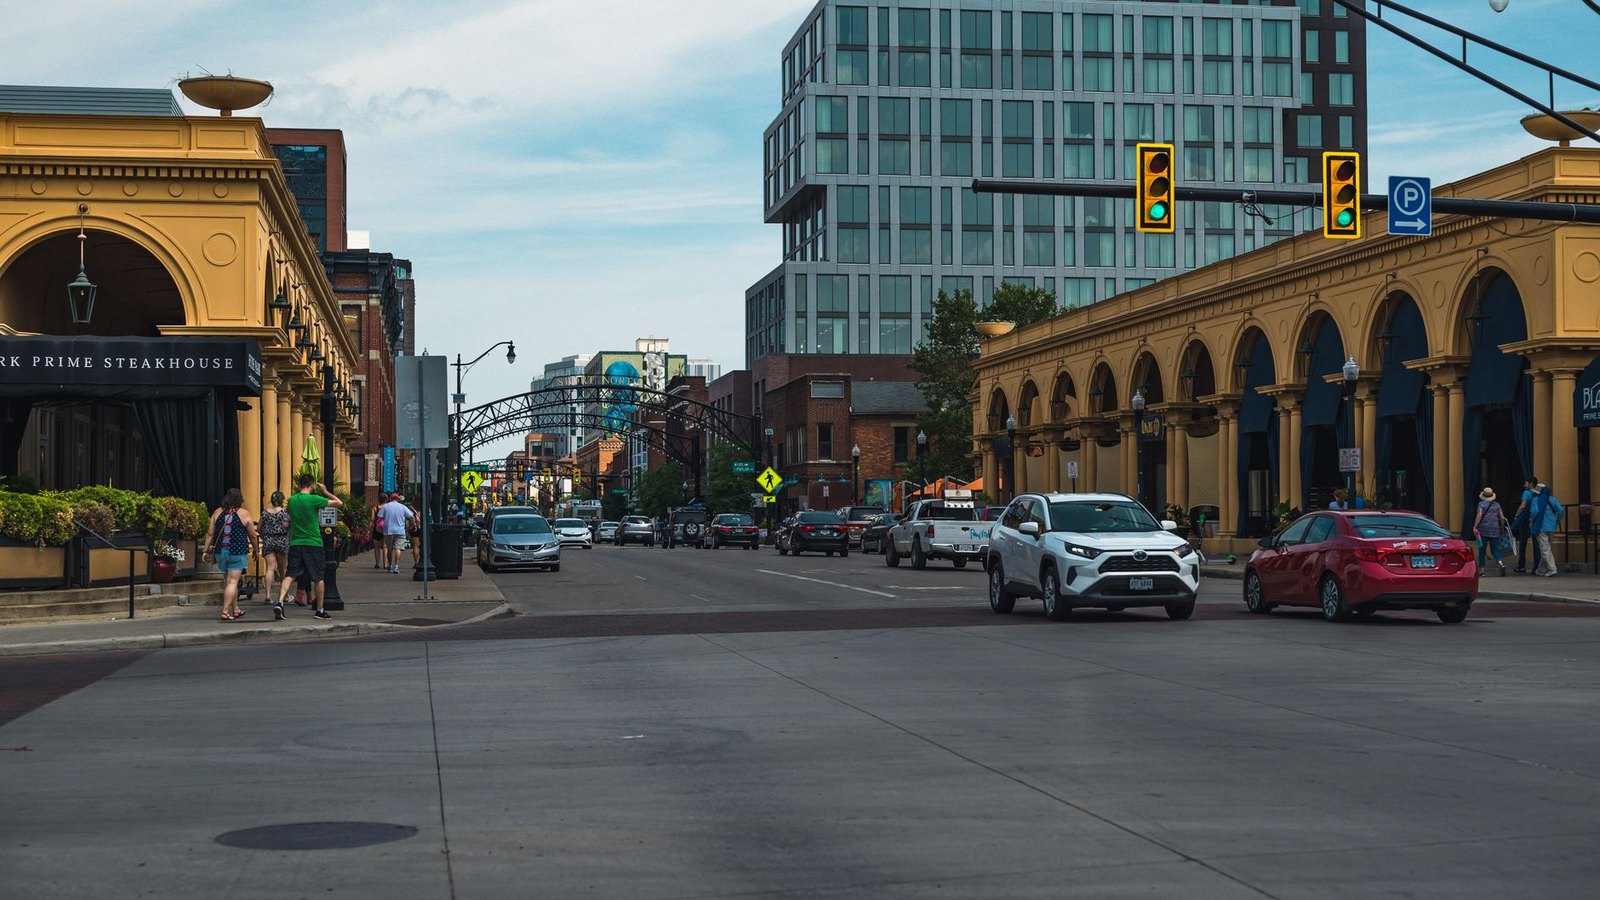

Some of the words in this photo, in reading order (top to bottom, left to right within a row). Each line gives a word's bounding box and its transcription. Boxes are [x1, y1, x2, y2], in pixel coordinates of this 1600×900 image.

[1404, 187, 1419, 208] P
[32, 356, 93, 368] PRIME
[104, 358, 234, 369] STEAKHOUSE
